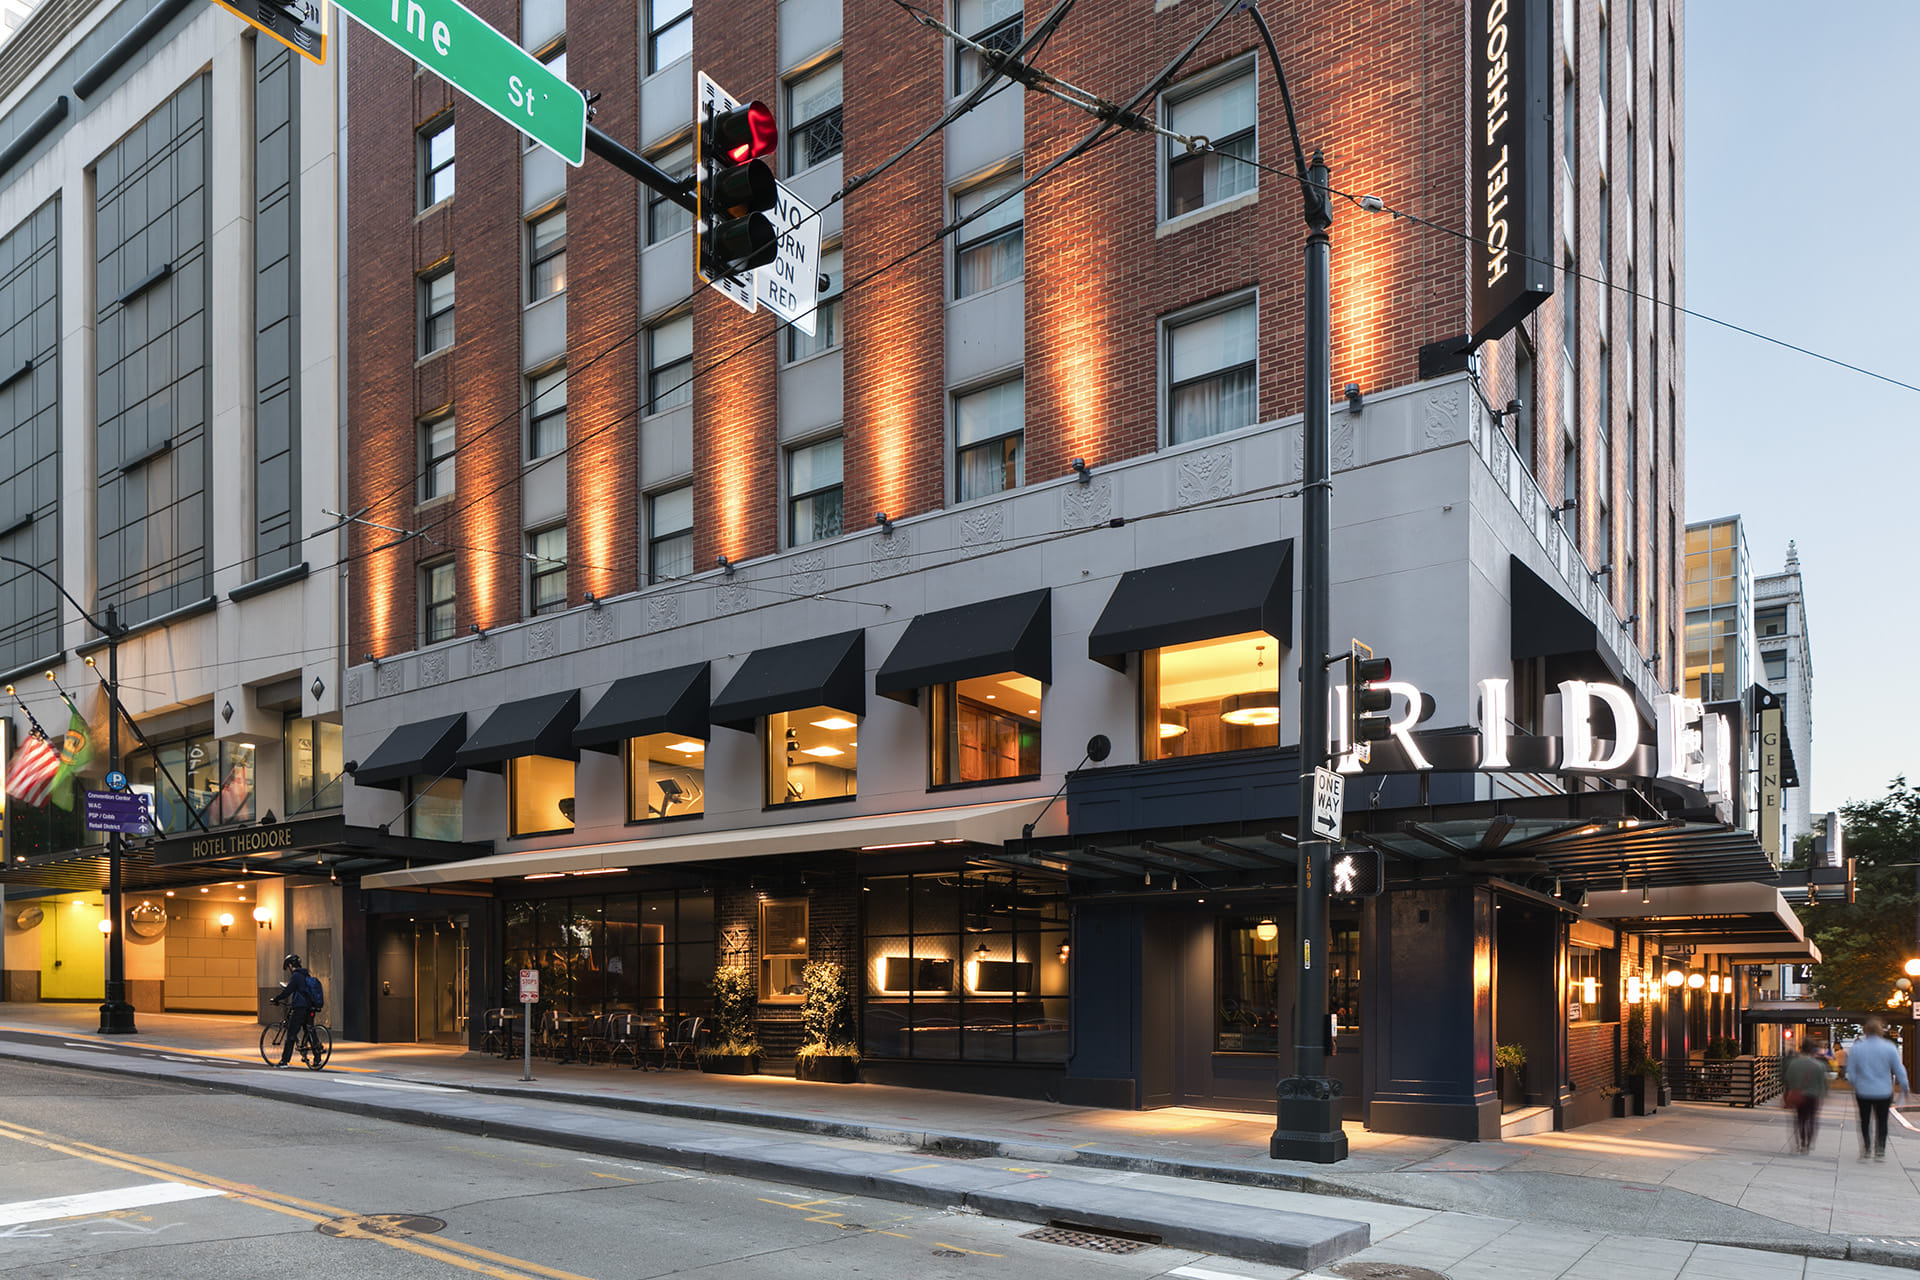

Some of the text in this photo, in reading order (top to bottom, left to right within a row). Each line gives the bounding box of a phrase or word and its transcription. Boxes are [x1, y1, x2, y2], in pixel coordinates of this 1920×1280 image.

[507, 75, 535, 117] St
[774, 199, 802, 230] NO
[1487, 144, 1509, 289] HOTEL
[771, 222, 806, 264] URN
[775, 256, 795, 284] ON
[769, 280, 797, 313] RED
[1318, 774, 1340, 796] ONE
[1763, 732, 1777, 807] GENE
[87, 792, 115, 800] Convention
[1317, 791, 1340, 813] WAY
[192, 828, 292, 858] HOTEL THEODORE
